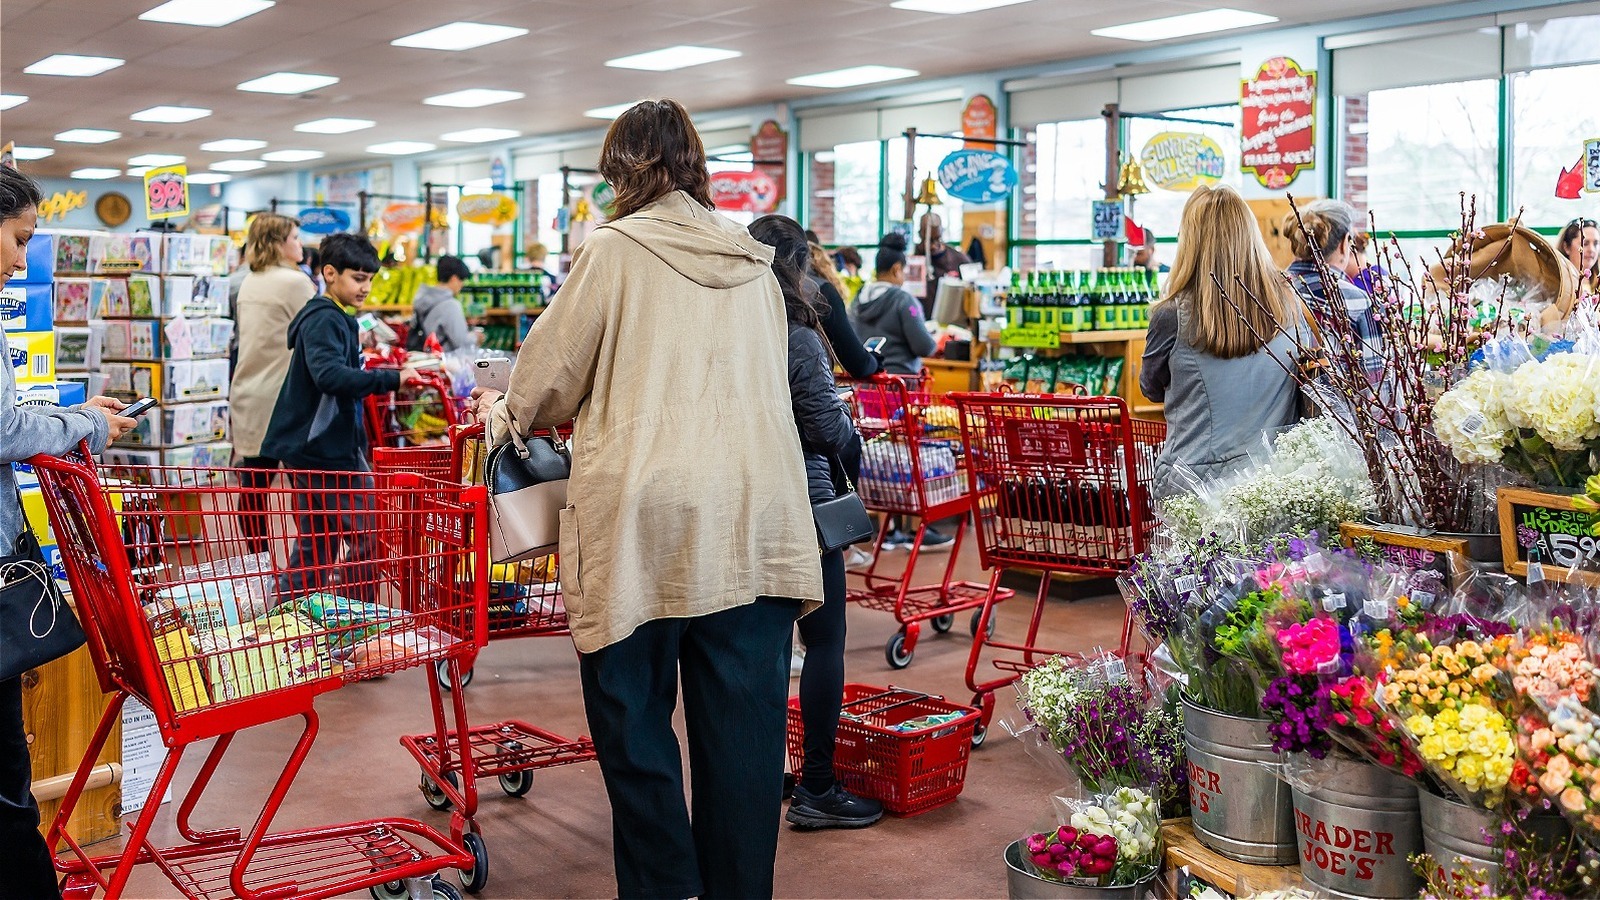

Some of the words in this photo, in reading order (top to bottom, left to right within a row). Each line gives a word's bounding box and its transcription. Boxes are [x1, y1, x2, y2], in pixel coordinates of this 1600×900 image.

[1141, 136, 1205, 161] SUNRISE
[1243, 152, 1281, 166] TRADER
[1188, 760, 1223, 795] DER
[1294, 808, 1395, 856] TRADER
[1303, 840, 1377, 880] JOE'S
